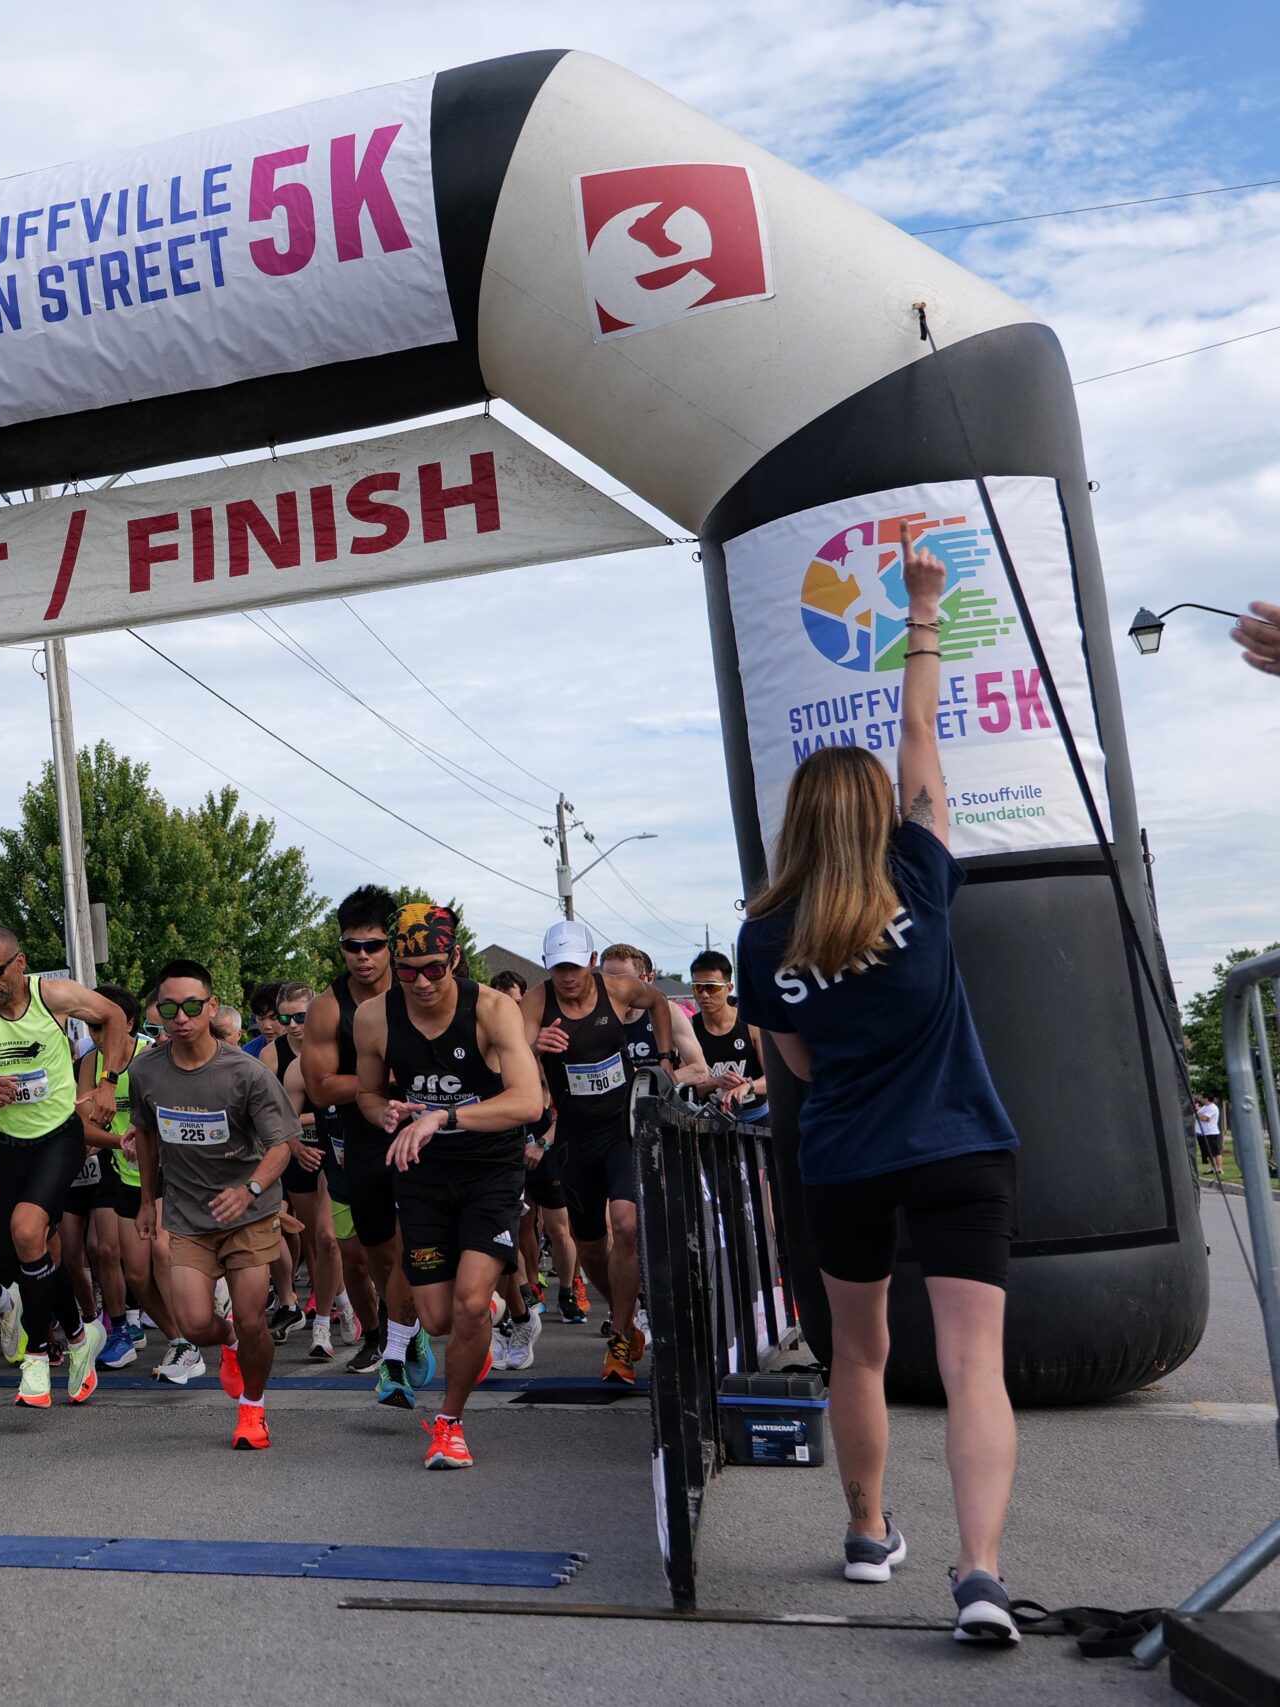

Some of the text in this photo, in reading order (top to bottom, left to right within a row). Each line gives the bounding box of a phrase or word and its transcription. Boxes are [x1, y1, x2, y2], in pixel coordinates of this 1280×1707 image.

[247, 123, 414, 277] 5K
[40, 226, 229, 324] STREET
[42, 509, 87, 621] /
[126, 451, 502, 594] FINISH
[789, 676, 969, 735] STOUFFVE
[974, 667, 1053, 735] 5K
[865, 709, 968, 751] STET
[961, 783, 1043, 807] Stouffville
[954, 803, 1046, 826] Foundation
[586, 1070, 609, 1079] ERNEST
[588, 1076, 610, 1092] 790
[14, 1088, 31, 1101] 96
[453, 1092, 474, 1100] crew
[180, 1128, 206, 1142] 225
[76, 1162, 98, 1180] 02
[492, 1236, 514, 1248] adidas
[751, 1424, 798, 1432] MASTERCRAFT
